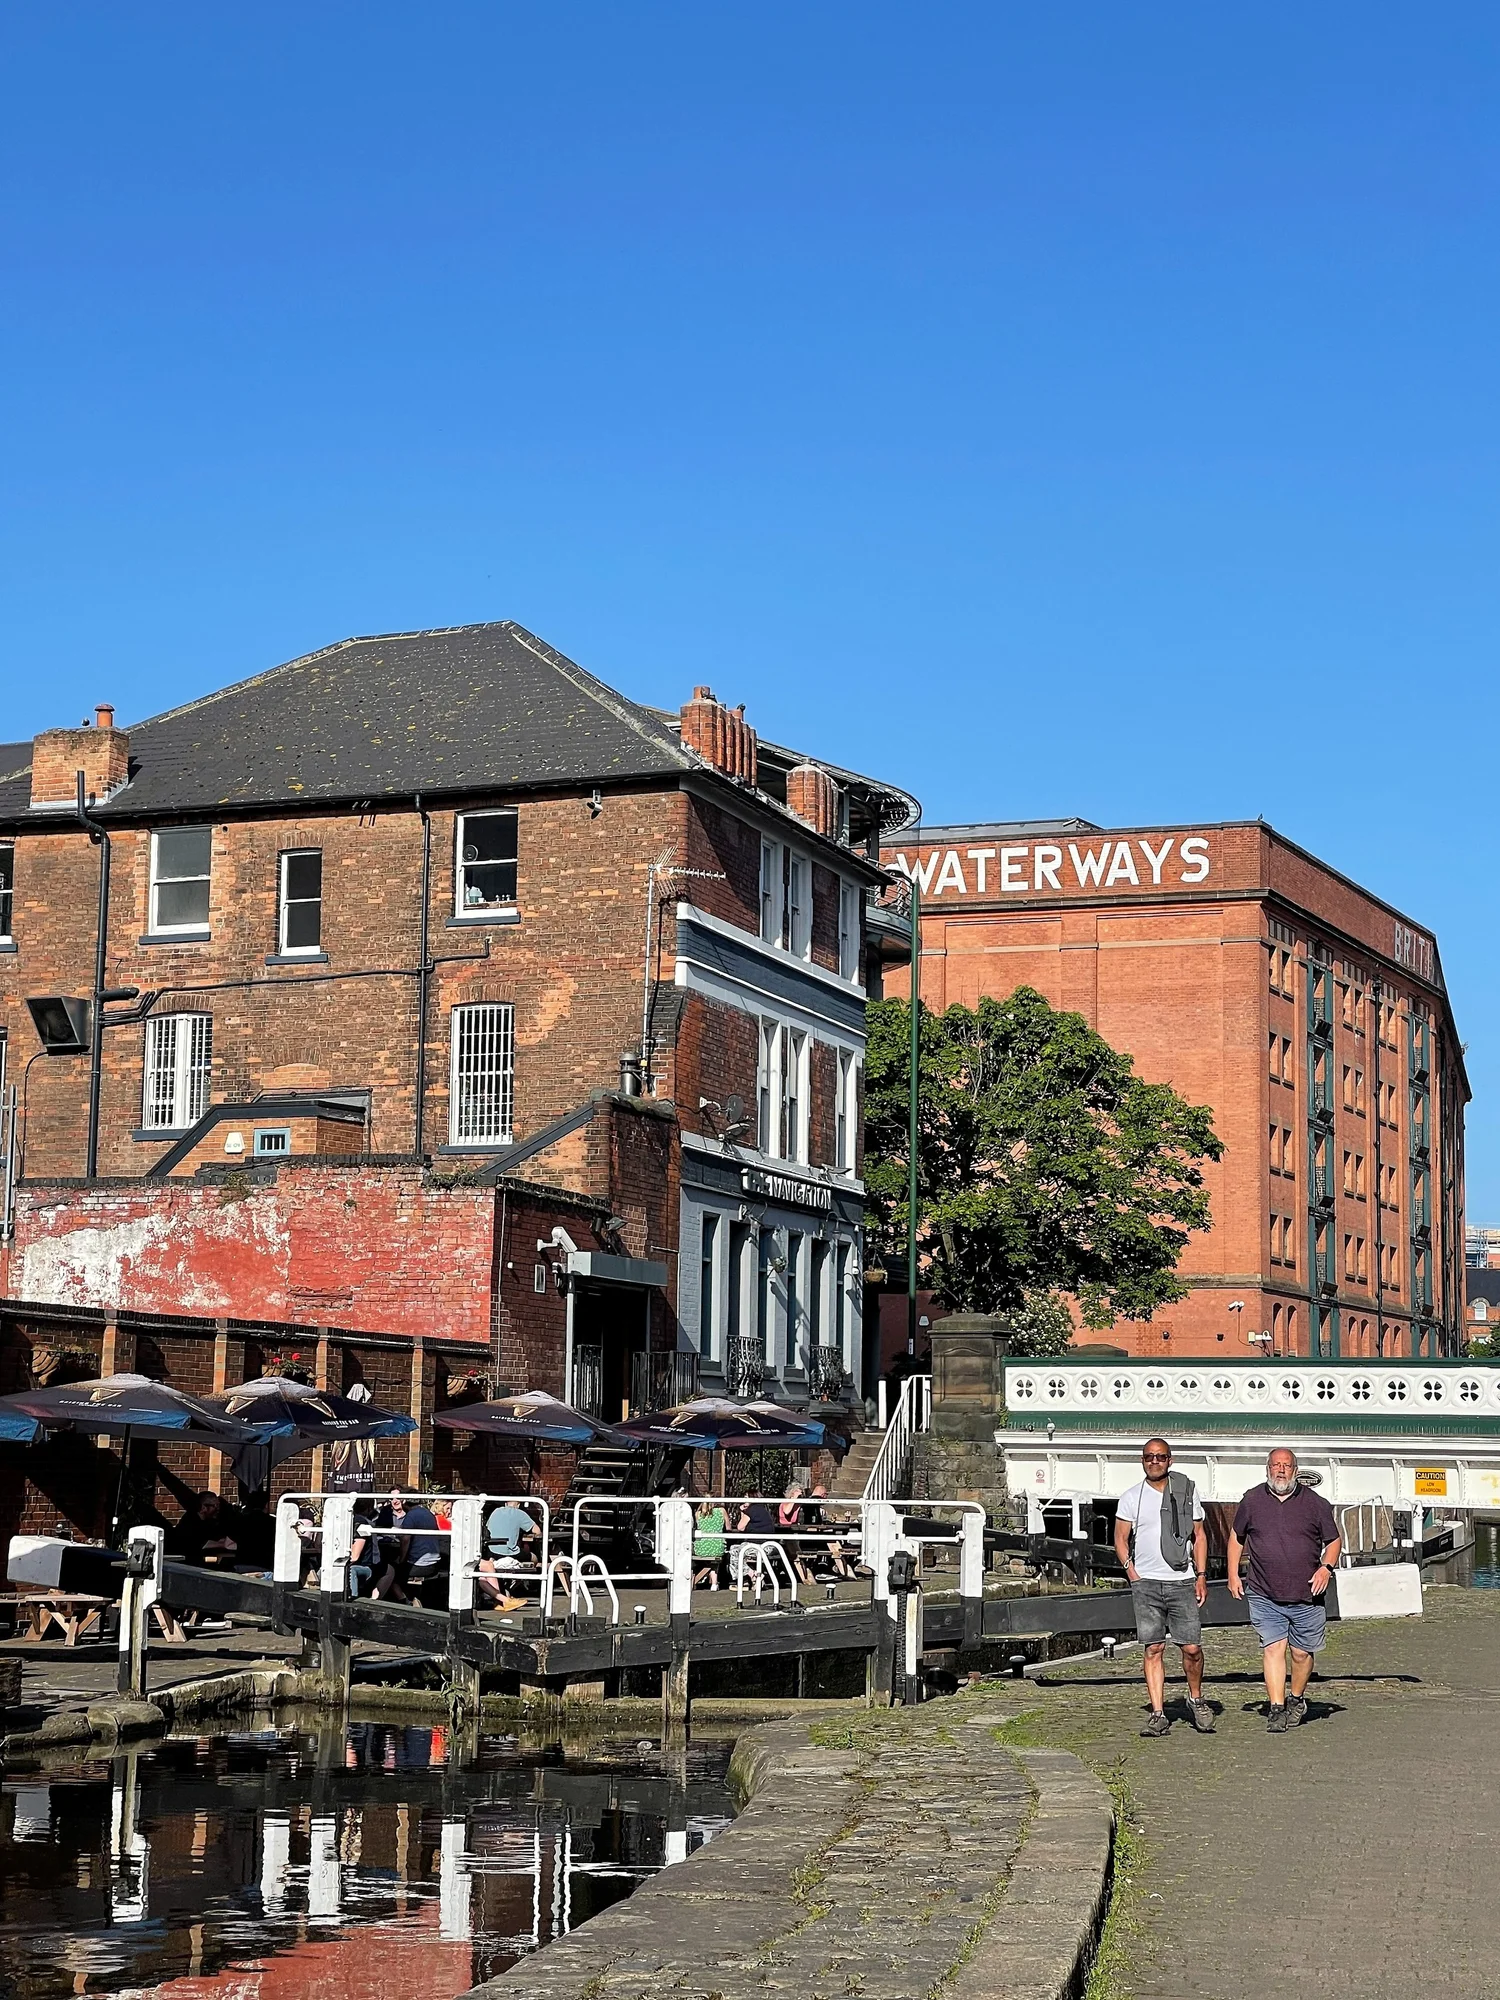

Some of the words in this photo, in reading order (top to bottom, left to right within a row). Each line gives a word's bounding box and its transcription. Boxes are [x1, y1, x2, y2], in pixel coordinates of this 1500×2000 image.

[896, 837, 1211, 895] WATERWAYS
[771, 1175, 832, 1210] NAVIGATION
[1416, 1472, 1446, 1480] CAUTION
